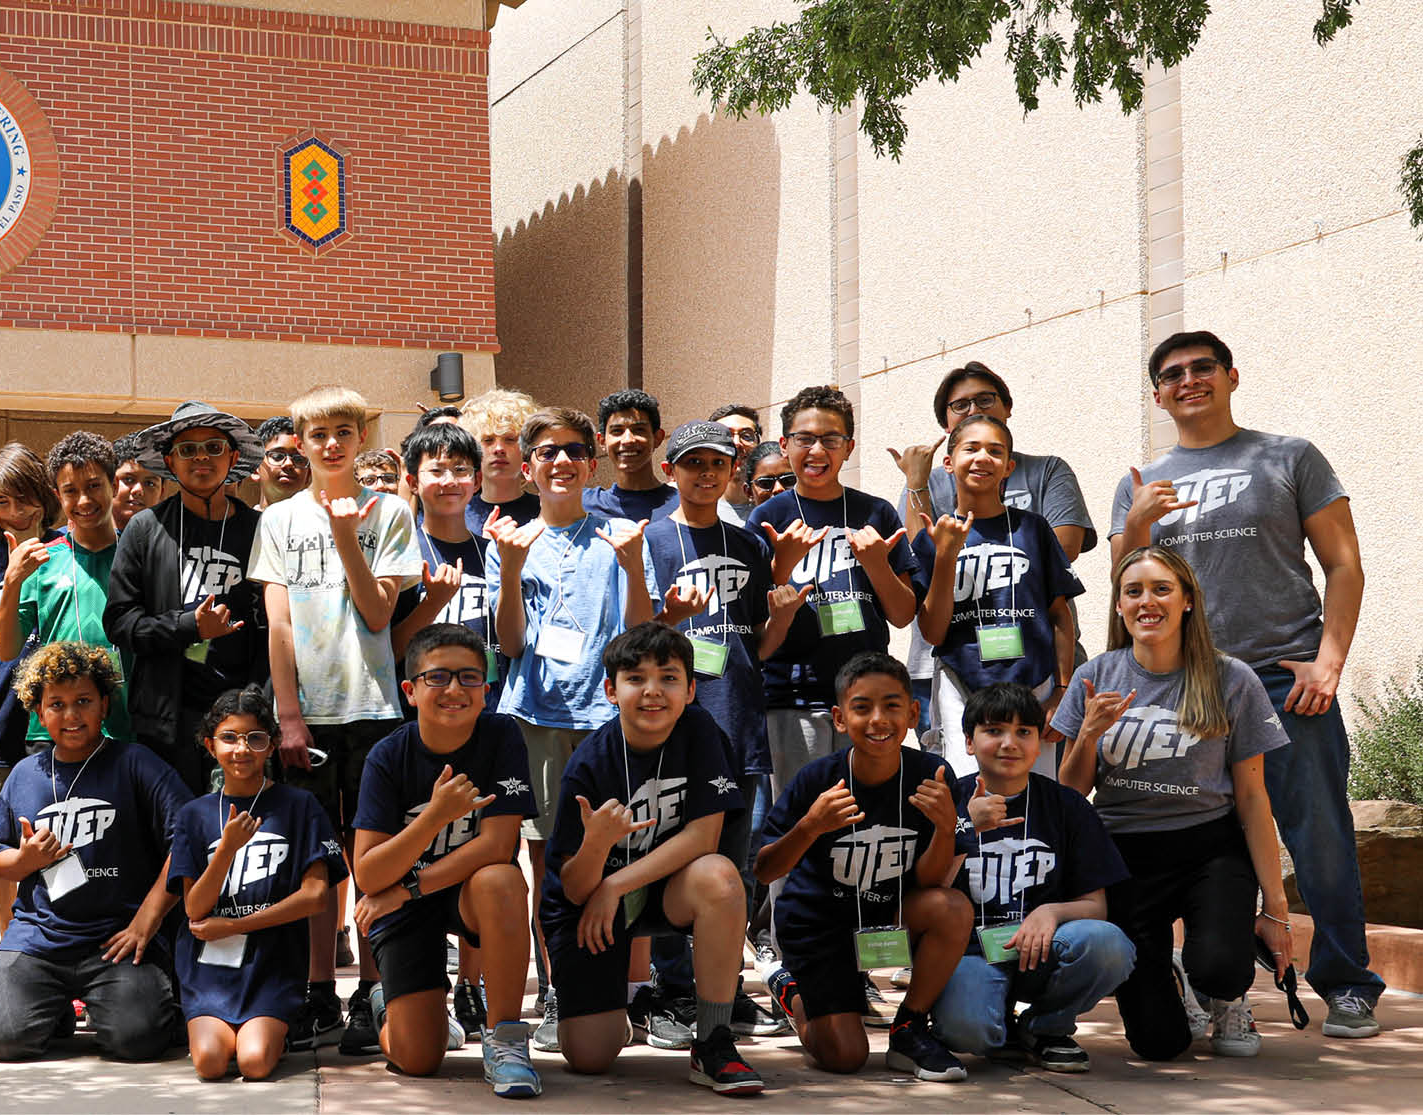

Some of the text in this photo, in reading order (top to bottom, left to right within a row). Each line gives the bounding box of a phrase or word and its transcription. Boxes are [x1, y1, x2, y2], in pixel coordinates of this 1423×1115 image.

[7, 184, 26, 215] PASO
[1158, 468, 1253, 527] UTEP
[1214, 527, 1258, 540] SCIENCE
[791, 526, 863, 585] UTE
[953, 542, 1030, 602] UTEP
[806, 591, 845, 603] MPUTER
[997, 608, 1035, 618] SCIENCE
[684, 624, 734, 639] COMPUTER
[1102, 704, 1202, 770] UTEP
[1153, 782, 1201, 797] SCIENCE
[84, 867, 119, 878] CIENCE
[207, 831, 291, 898] TEP
[965, 837, 1056, 905] UTEP
